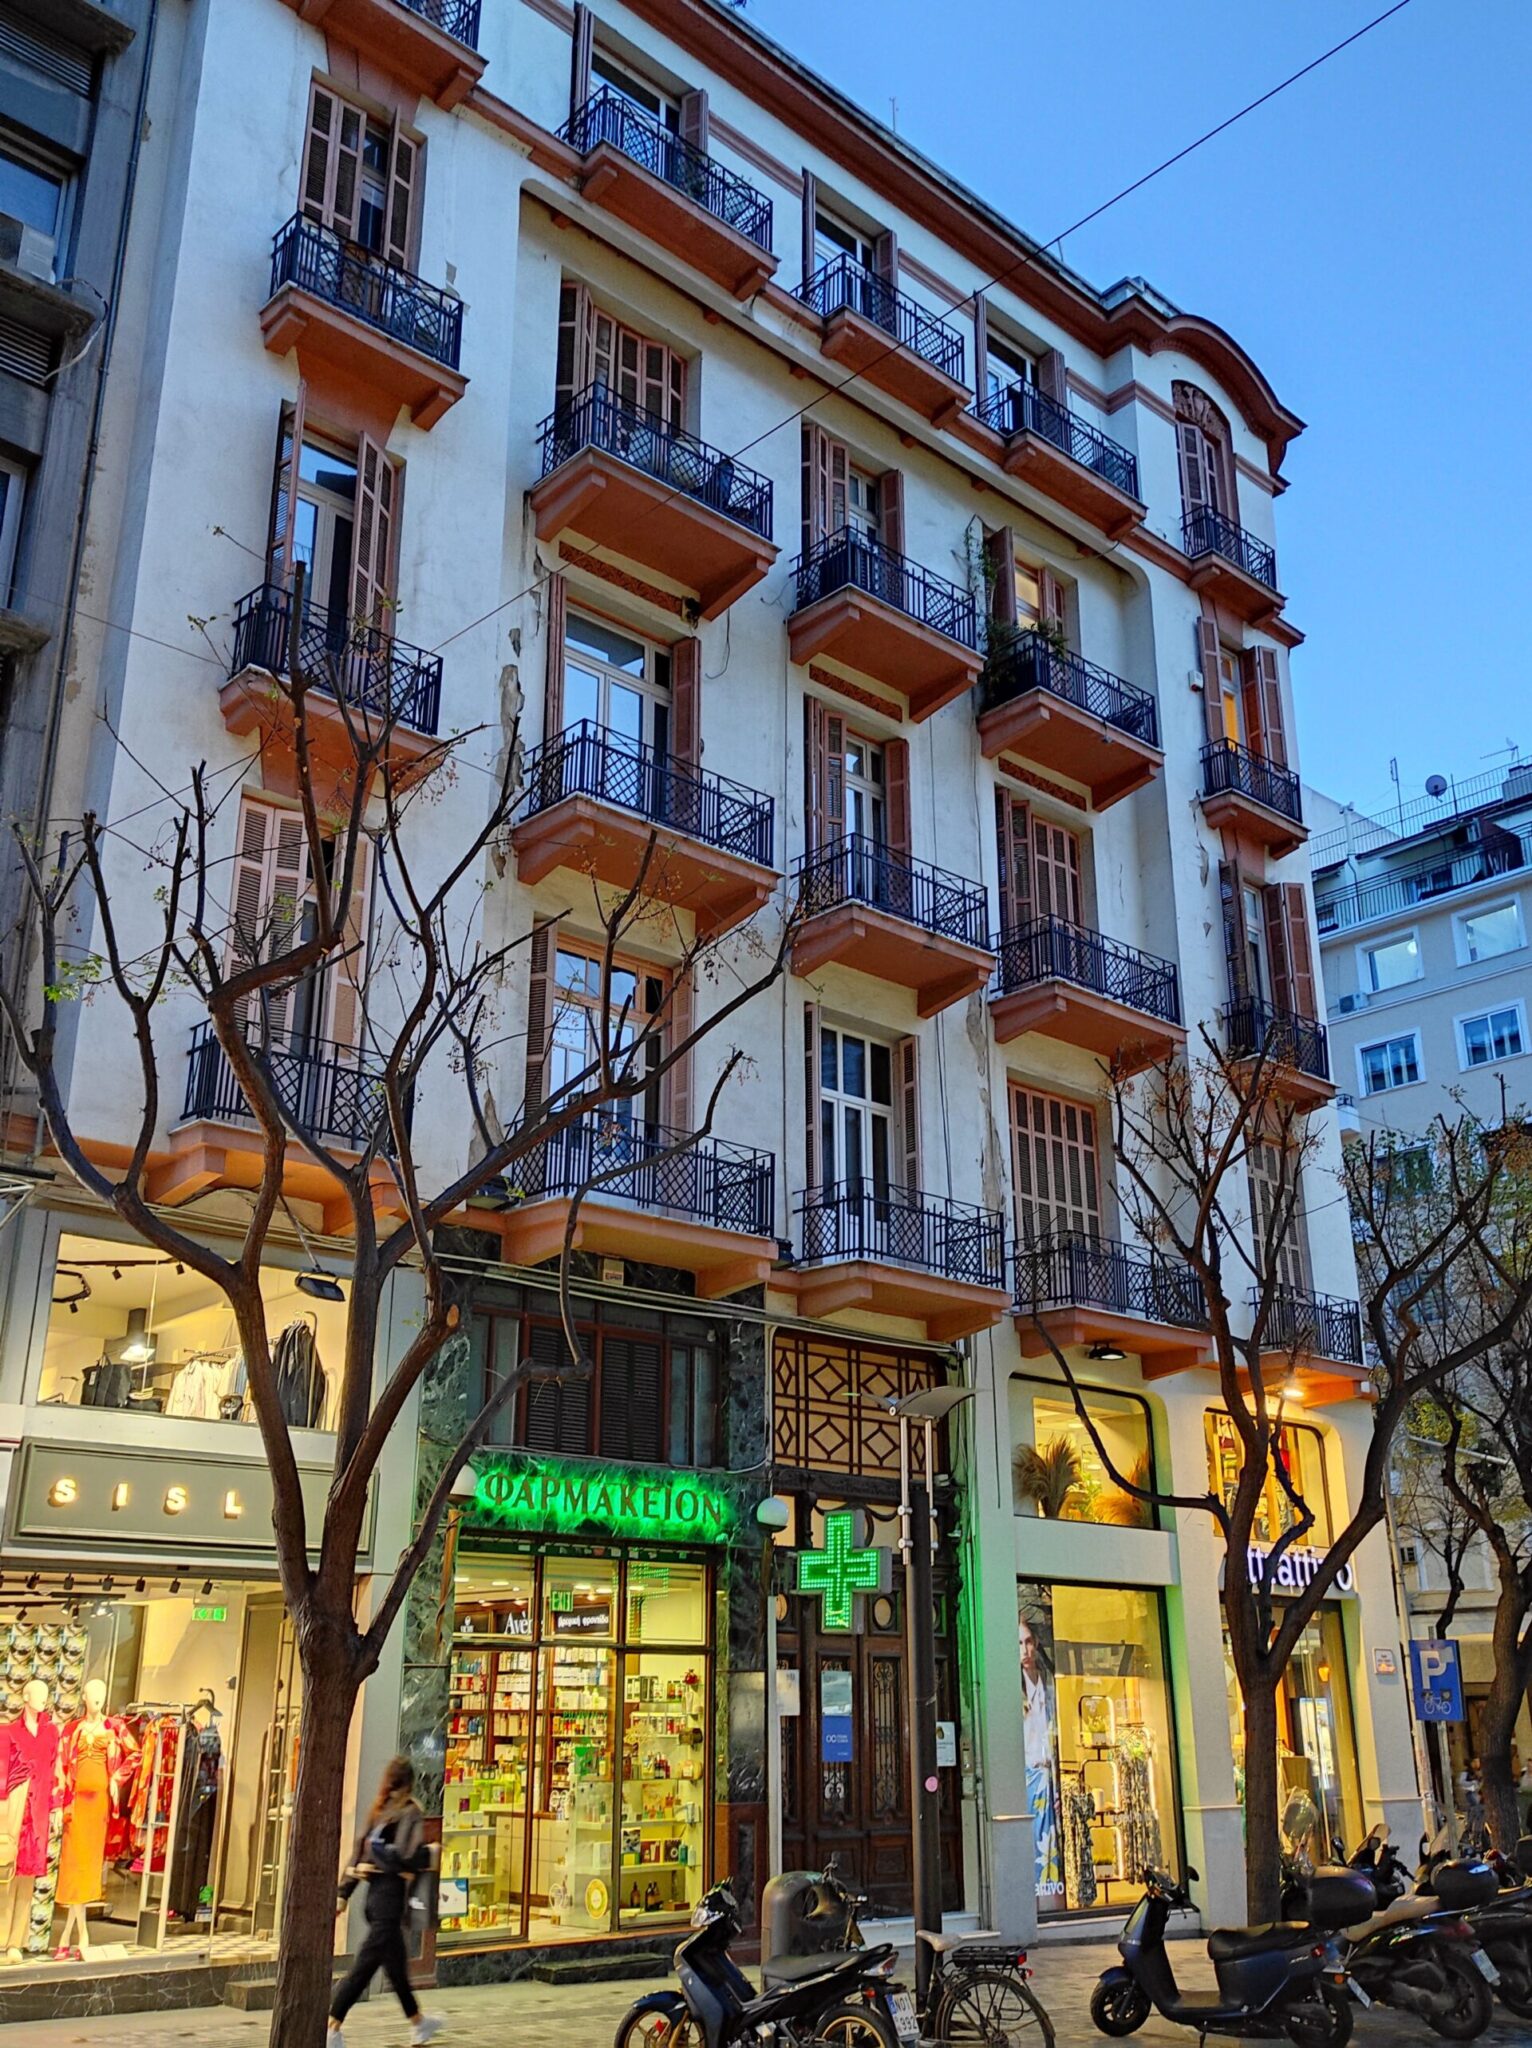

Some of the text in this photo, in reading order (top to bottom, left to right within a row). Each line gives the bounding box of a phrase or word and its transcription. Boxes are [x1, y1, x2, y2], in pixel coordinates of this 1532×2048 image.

[49, 1477, 244, 1519] SISL
[485, 1472, 721, 1526] ΦΑΡΜΑΚΕΙΟΝ
[1419, 1650, 1448, 1689] P
